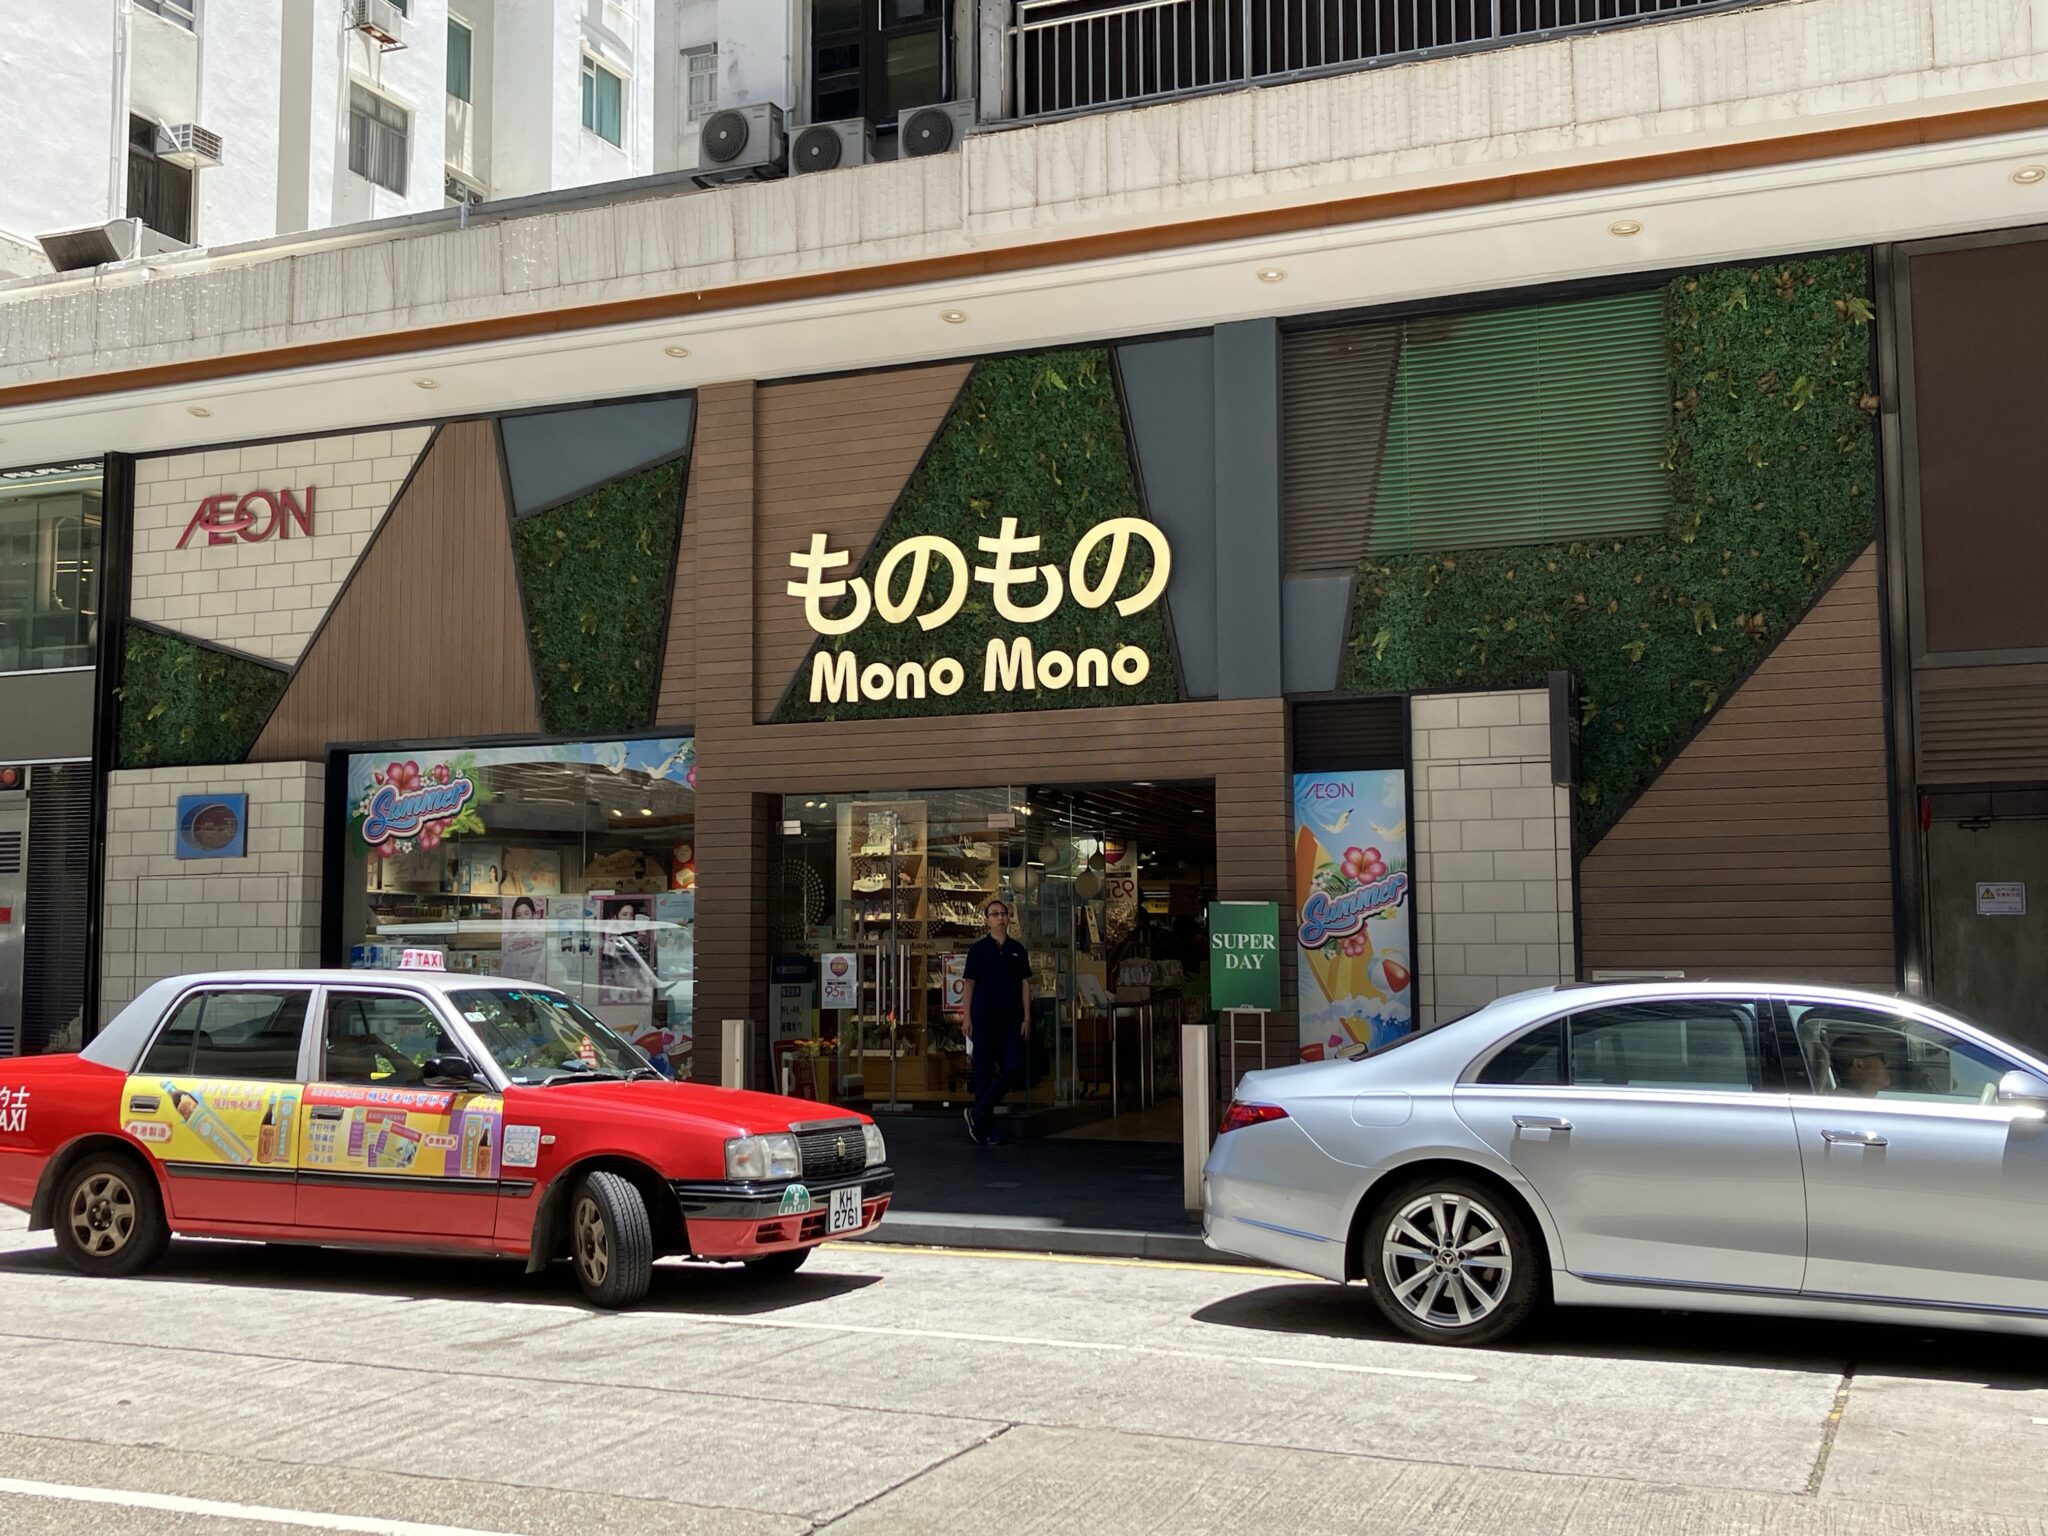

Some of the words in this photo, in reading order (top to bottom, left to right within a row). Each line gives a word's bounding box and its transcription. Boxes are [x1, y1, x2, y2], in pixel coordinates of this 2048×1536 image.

[786, 517, 1172, 635] ものもの
[809, 650, 965, 703] Mono
[983, 636, 1150, 692] Mono
[365, 782, 469, 839] Summer
[1301, 873, 1406, 943] Summer
[1212, 933, 1276, 950] SUPER
[416, 952, 442, 967] TAXI
[1224, 954, 1265, 970] DAY
[0, 1109, 27, 1132] AXI
[130, 1125, 167, 1138] 香港製造
[839, 1189, 853, 1210] KH
[834, 1208, 859, 1229] 2761
